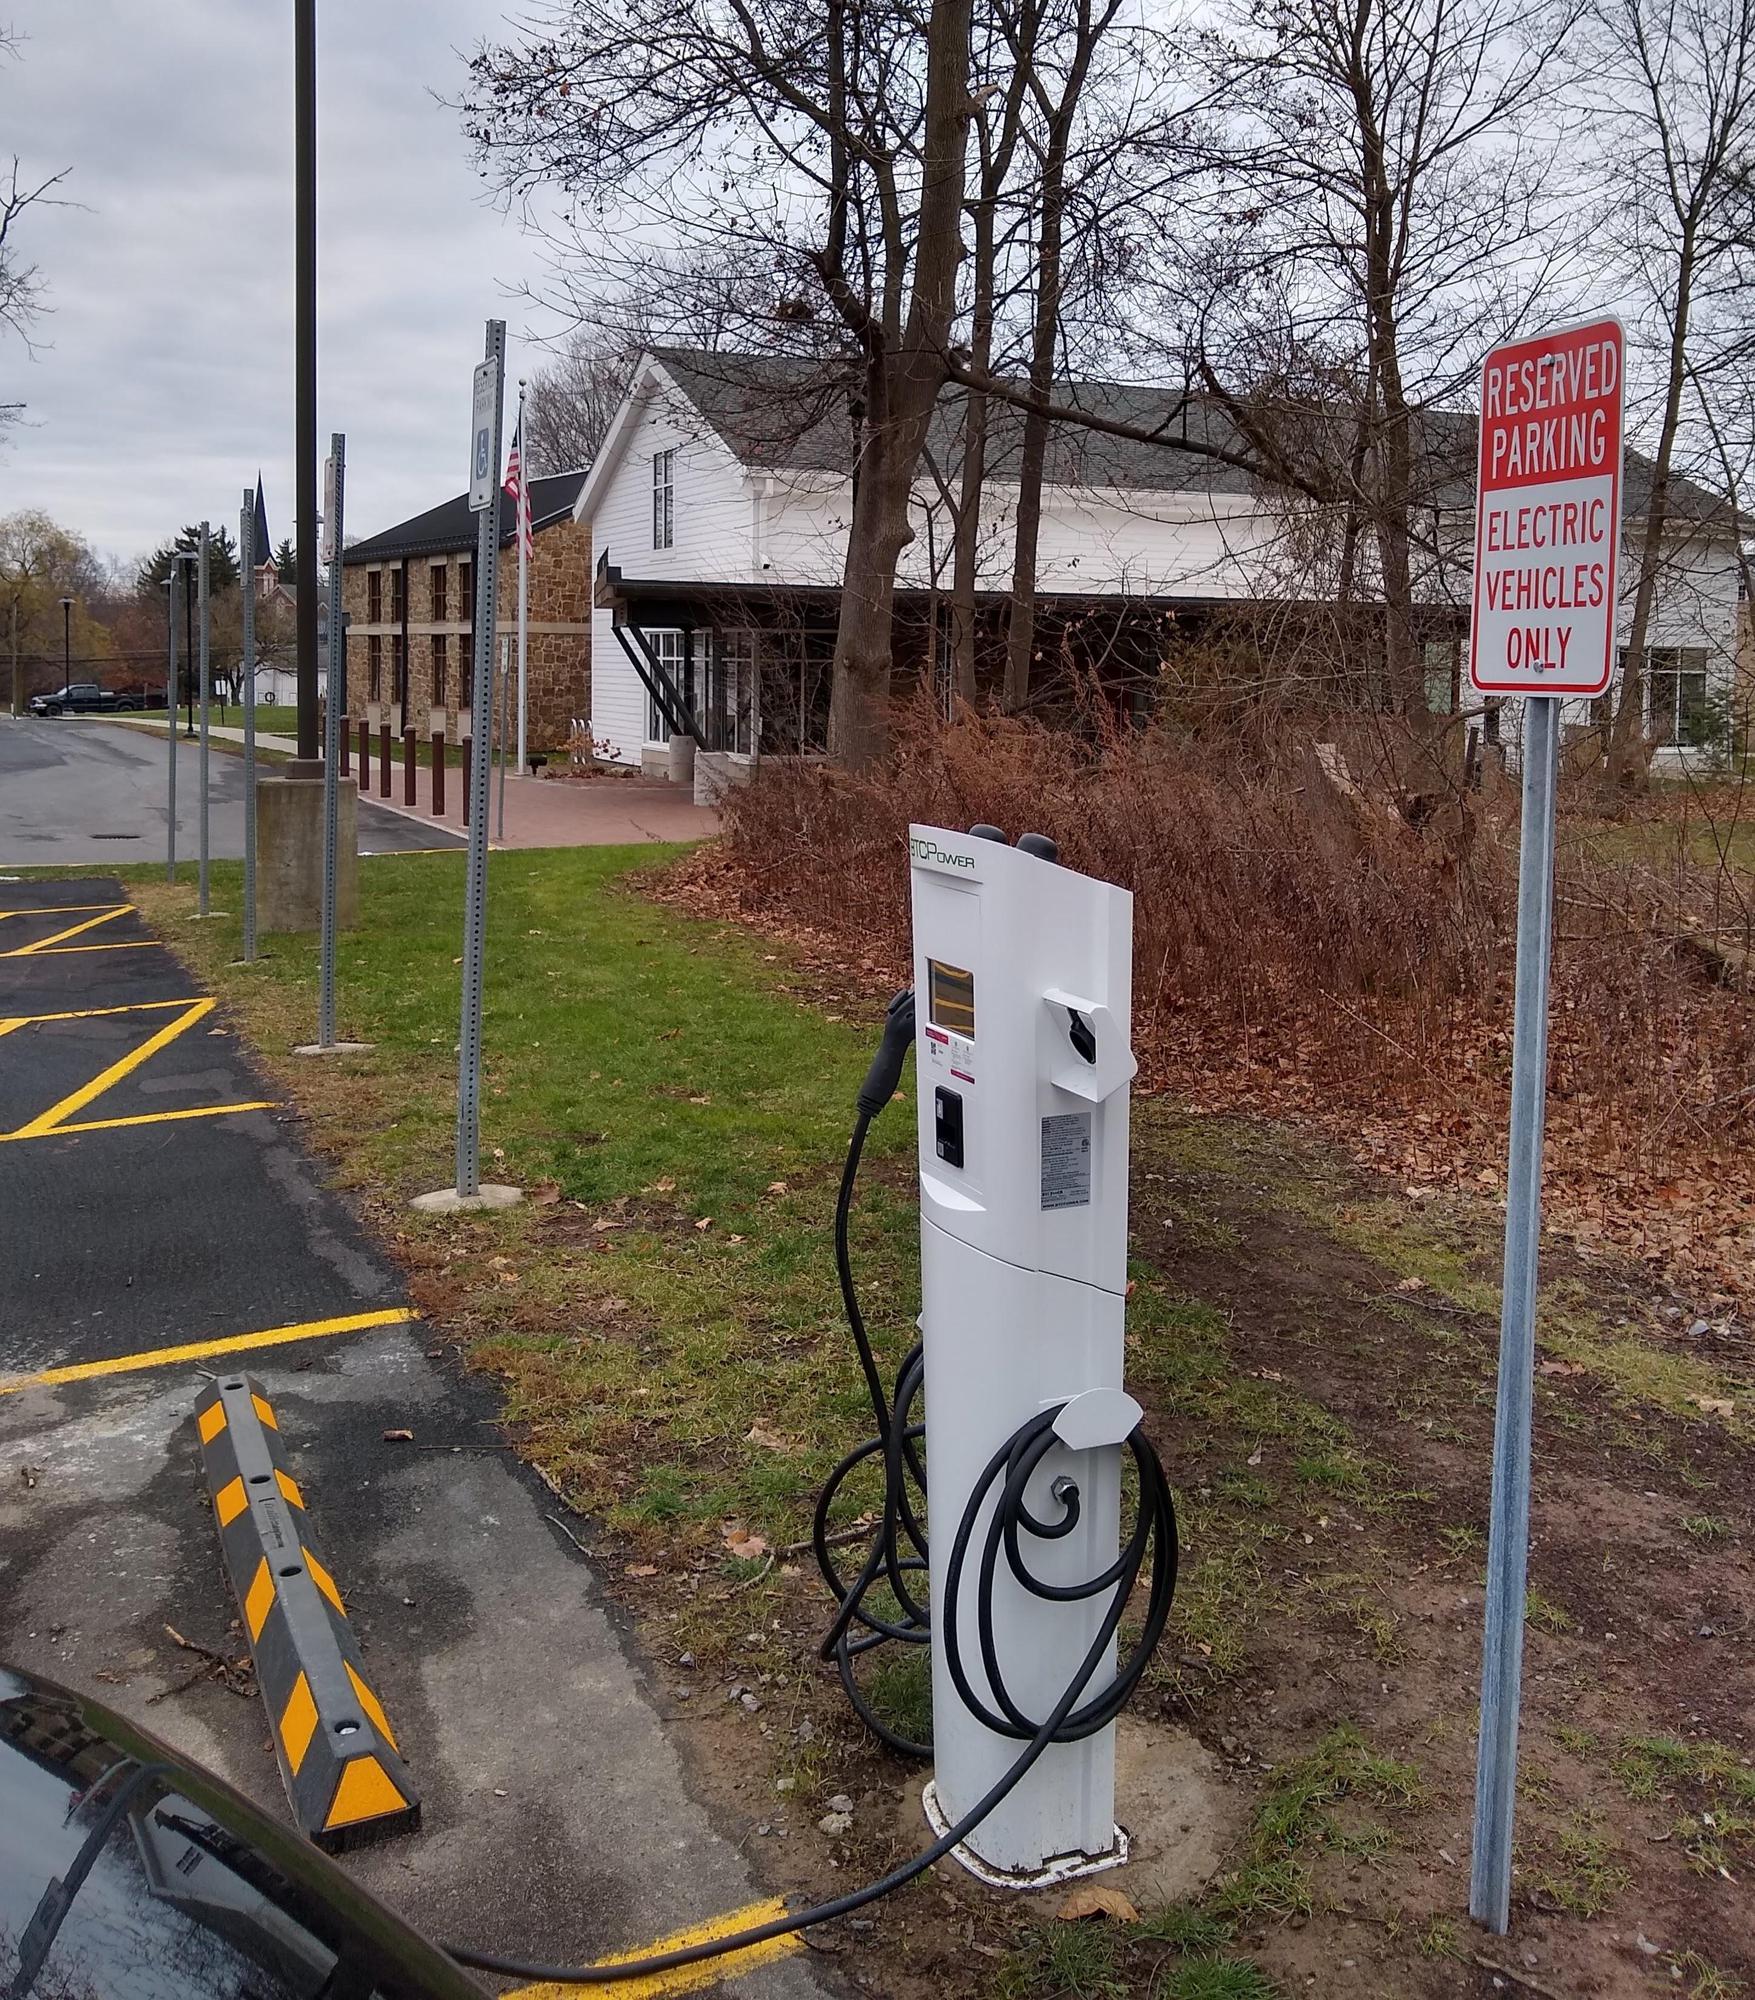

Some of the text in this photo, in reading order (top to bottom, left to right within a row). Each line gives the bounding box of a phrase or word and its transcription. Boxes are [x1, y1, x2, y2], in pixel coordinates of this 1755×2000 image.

[1487, 340, 1618, 419] RESERVED
[1492, 408, 1606, 480] PARKING
[1488, 498, 1604, 552] ELECTRIC
[1486, 562, 1604, 611] VEHICLES
[1506, 626, 1572, 669] ONLY
